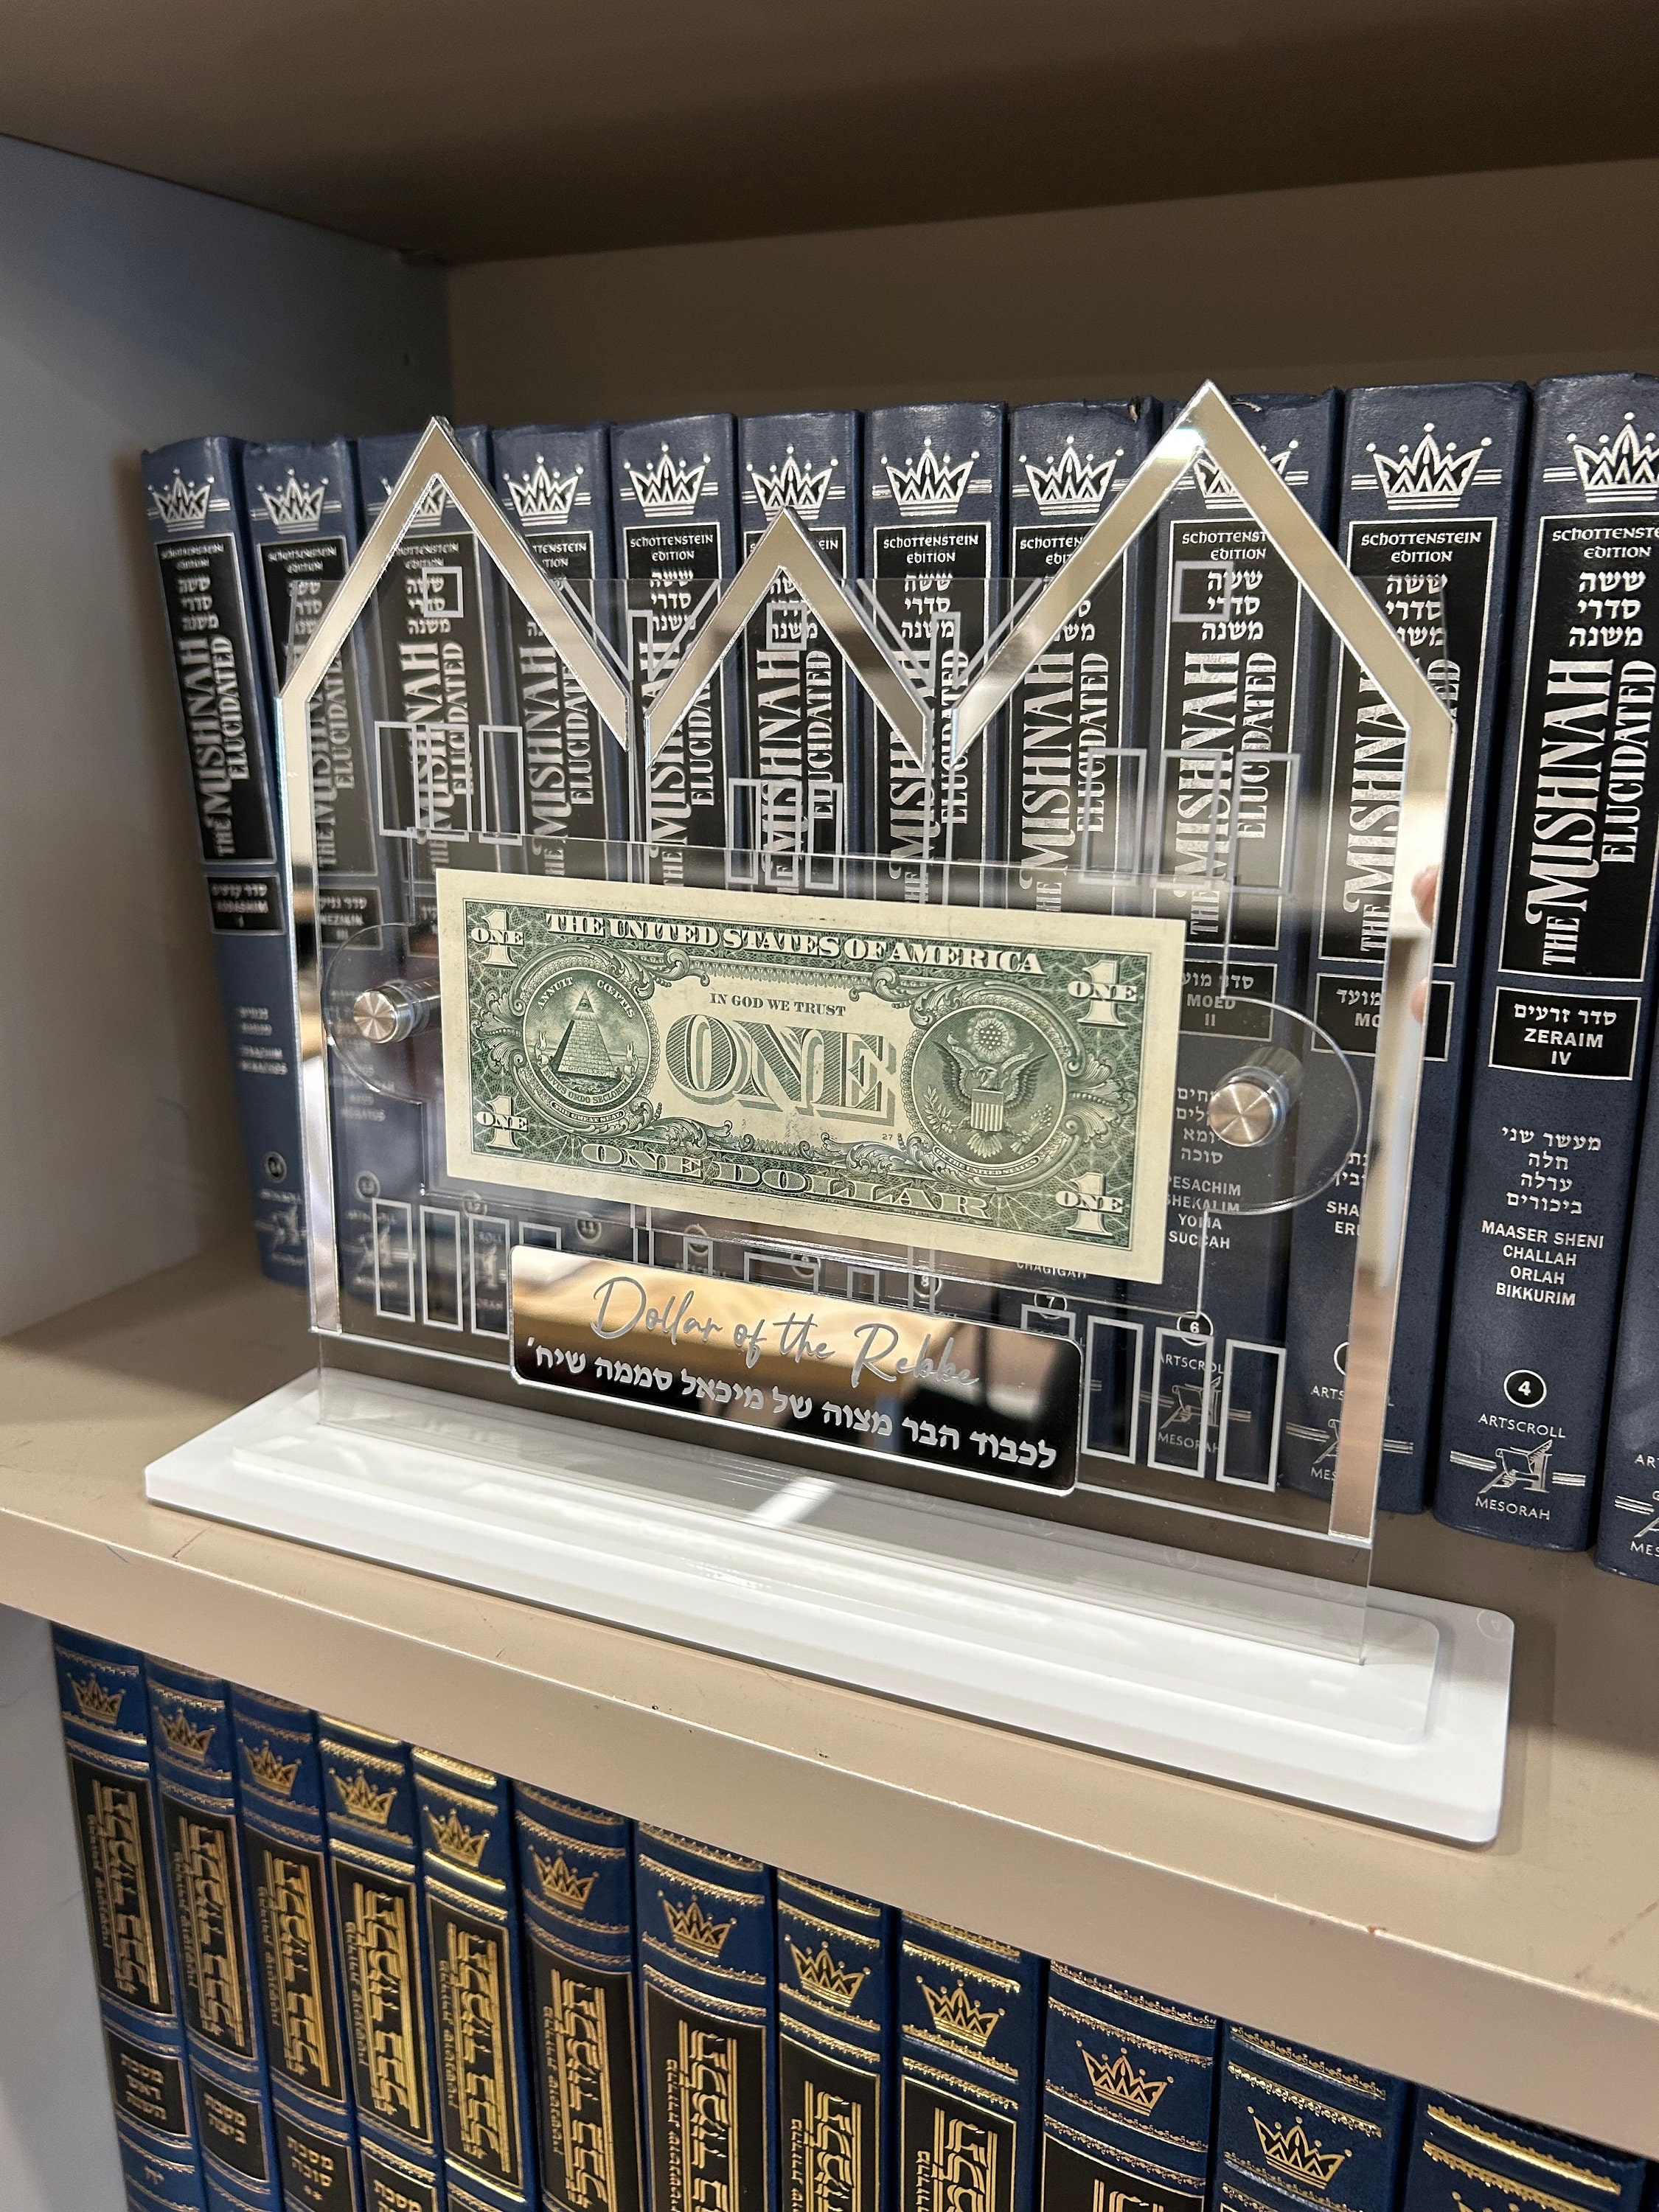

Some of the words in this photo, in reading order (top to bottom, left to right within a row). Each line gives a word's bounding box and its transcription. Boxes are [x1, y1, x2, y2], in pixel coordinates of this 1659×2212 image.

[532, 542, 587, 554] TTENSTEIN
[630, 535, 714, 548] SCHOTTENSTEIN
[883, 535, 979, 549] SCHOTTENSTEIN
[1182, 531, 1267, 544] SCHOTTENST
[1361, 532, 1482, 546] SCHOTTENSTEIN
[651, 551, 695, 561] EDITION
[906, 552, 956, 563] EDITION
[1210, 549, 1267, 560] EDITION
[1391, 551, 1453, 563] EDITION
[1584, 546, 1652, 558] EDITION
[1385, 574, 1448, 595] ששה
[1578, 571, 1646, 594] ששה
[651, 592, 692, 609] סדרי
[904, 597, 950, 615] סדרי
[1385, 600, 1444, 621] סדרי
[1578, 599, 1641, 620] סדרי
[407, 619, 451, 635] משנה
[1202, 620, 1264, 641] משנה
[1569, 626, 1644, 648] משנה
[519, 646, 571, 855] MISHNAH
[1077, 653, 1109, 833] ELUCIDATED
[1237, 652, 1277, 840] ELUCIDATED
[1020, 652, 1075, 889] MISHNAH
[1601, 659, 1657, 864] ELUCIDATED
[1172, 650, 1240, 898] MISHNAH
[1525, 658, 1613, 926] MISHNAH
[1191, 889, 1221, 935] THE
[471, 928, 524, 947] ONE
[1360, 905, 1392, 953] THE
[1543, 911, 1579, 966] THE
[546, 914, 605, 938] THE
[608, 919, 720, 948] UNITED
[723, 928, 841, 960] STATES
[844, 937, 892, 966] OF
[893, 943, 1048, 975] AMERICA
[538, 976, 574, 1010] ANNUIT
[1067, 981, 1138, 1003] ONE
[1186, 993, 1237, 1010] MOED
[709, 992, 727, 1005] IN
[731, 994, 763, 1009] GOD
[766, 998, 790, 1012] WE
[794, 1001, 846, 1018] TRUST
[1514, 1003, 1571, 1024] זרעים
[1205, 1013, 1216, 1026] II
[1578, 1009, 1618, 1026] סדר
[1523, 1027, 1604, 1048] ZERAIM
[1551, 1050, 1571, 1065] IV
[666, 1014, 896, 1127] ONE
[568, 1089, 591, 1104] ORDO
[476, 1110, 529, 1132] ONE
[882, 1133, 893, 1141] 27
[1502, 1126, 1534, 1144] שני
[1543, 1132, 1601, 1151] מעשר
[1181, 1147, 1224, 1164] סוכה
[1528, 1151, 1568, 1170] חלה
[581, 1143, 706, 1179] ONE
[712, 1161, 993, 1222] DOLLAR
[1168, 1176, 1242, 1197] ESACHIM
[1520, 1170, 1573, 1192] ערלה
[1054, 1191, 1125, 1214] ONE
[1506, 1192, 1582, 1214] ביכורים
[1481, 1220, 1548, 1244] MAASER
[1553, 1232, 1604, 1249] SHENI
[1503, 1245, 1576, 1267] CHALLAH
[1510, 1265, 1565, 1284] ORLAH
[1495, 1282, 1576, 1306] BIKKURIM
[590, 1276, 724, 1346] Dollar
[732, 1319, 768, 1369] of
[772, 1312, 835, 1364] the
[851, 1323, 983, 1389] Rebbe
[1189, 1321, 1200, 1334] 6
[594, 1356, 674, 1391] סממה
[681, 1368, 765, 1410] מיכאל
[1518, 1381, 1531, 1396] 4
[771, 1385, 813, 1419] של
[821, 1402, 894, 1436] מצוה
[1478, 1413, 1566, 1439] ARTSCROLL
[901, 1416, 960, 1451] הבר
[969, 1430, 1057, 1469] לכבוד
[1475, 1496, 1551, 1520] MESORAH
[357, 1890, 402, 2021] תלמוד
[451, 1931, 494, 2063] תלמוד
[554, 1978, 600, 2111] תלמוד
[678, 2029, 729, 2169] תלמוד
[462, 2072, 501, 2160] בבלי
[565, 2119, 608, 2208] בבלי
